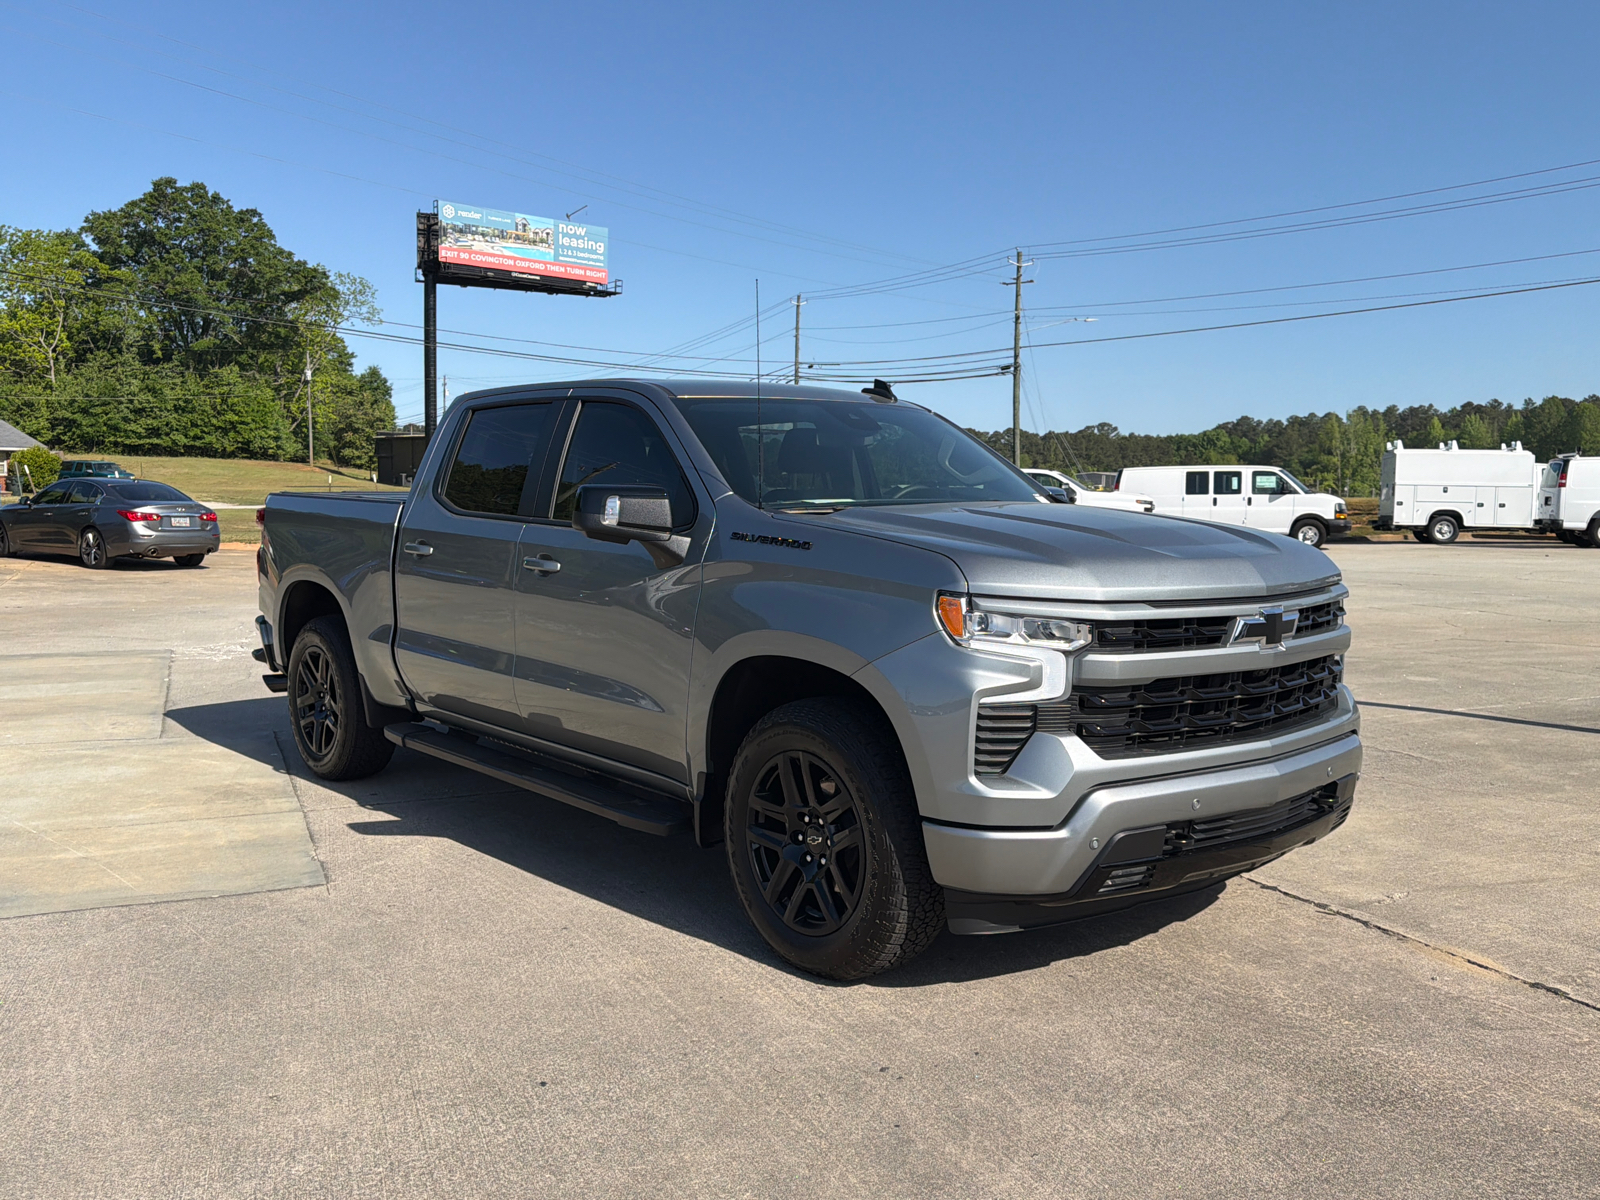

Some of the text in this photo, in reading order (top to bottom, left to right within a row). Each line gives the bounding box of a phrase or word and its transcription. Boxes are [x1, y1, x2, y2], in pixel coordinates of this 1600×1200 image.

[458, 210, 482, 219] render
[559, 223, 586, 236] now
[559, 233, 604, 253] leasing
[577, 251, 604, 260] bedrooms
[441, 249, 606, 279] EXIT 90 COVINGTON OXFORD THEN TURN RIGHT
[730, 531, 814, 551] SILVERADO
